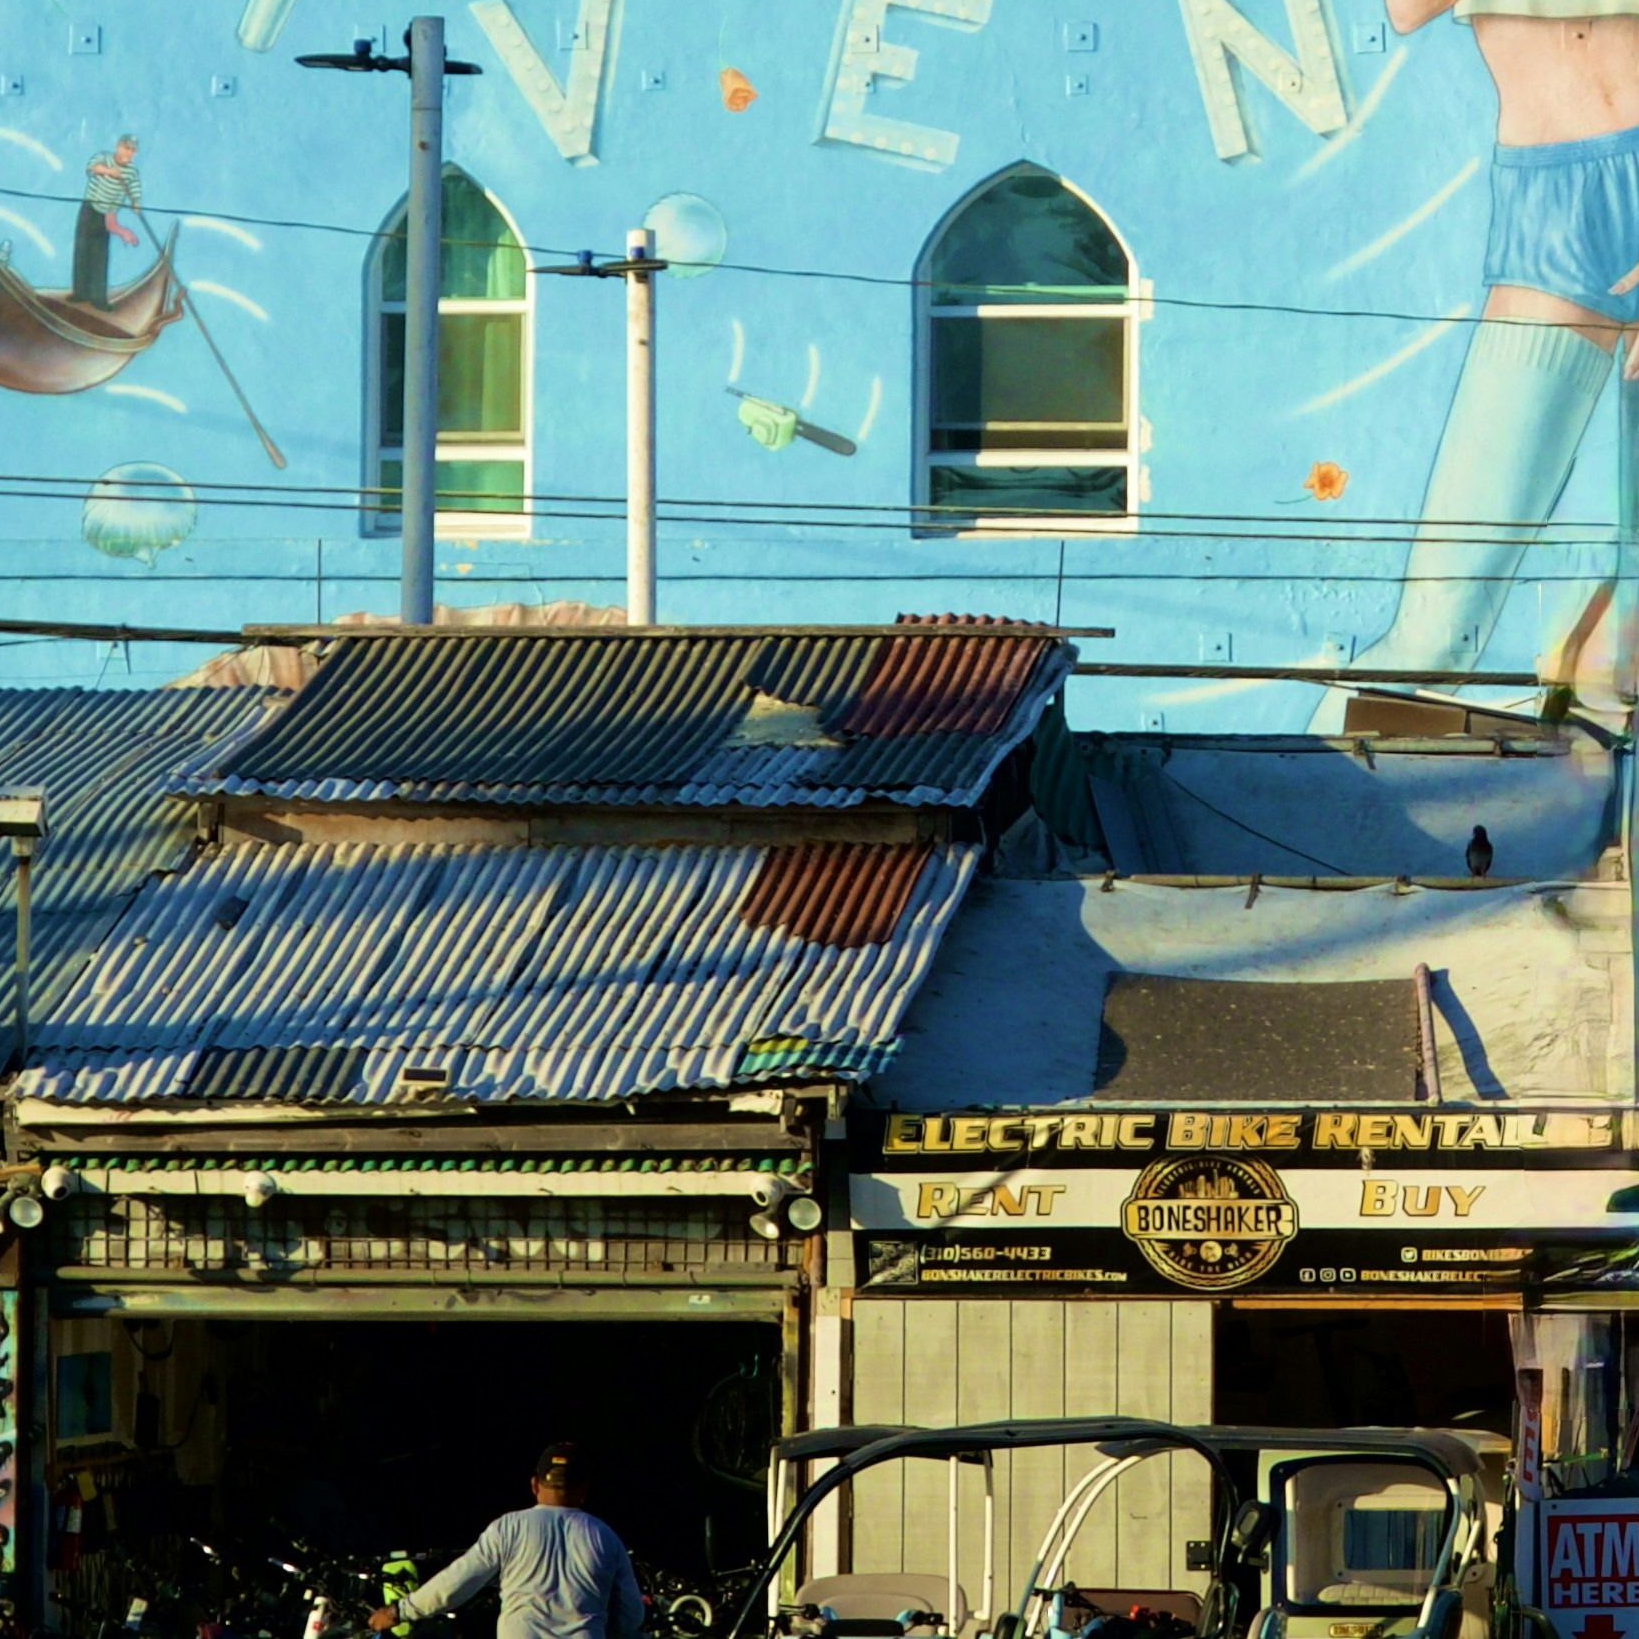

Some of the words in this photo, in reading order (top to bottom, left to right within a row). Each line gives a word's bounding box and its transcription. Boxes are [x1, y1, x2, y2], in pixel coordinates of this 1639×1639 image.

[882, 1113, 1157, 1155] ELECTRIC
[1165, 1112, 1302, 1151] BIKE
[917, 1181, 1067, 1219] RENT
[1360, 1179, 1486, 1218] BUY
[1137, 1205, 1285, 1236] BONESHAKER
[920, 1244, 1052, 1265] (310)560-4433
